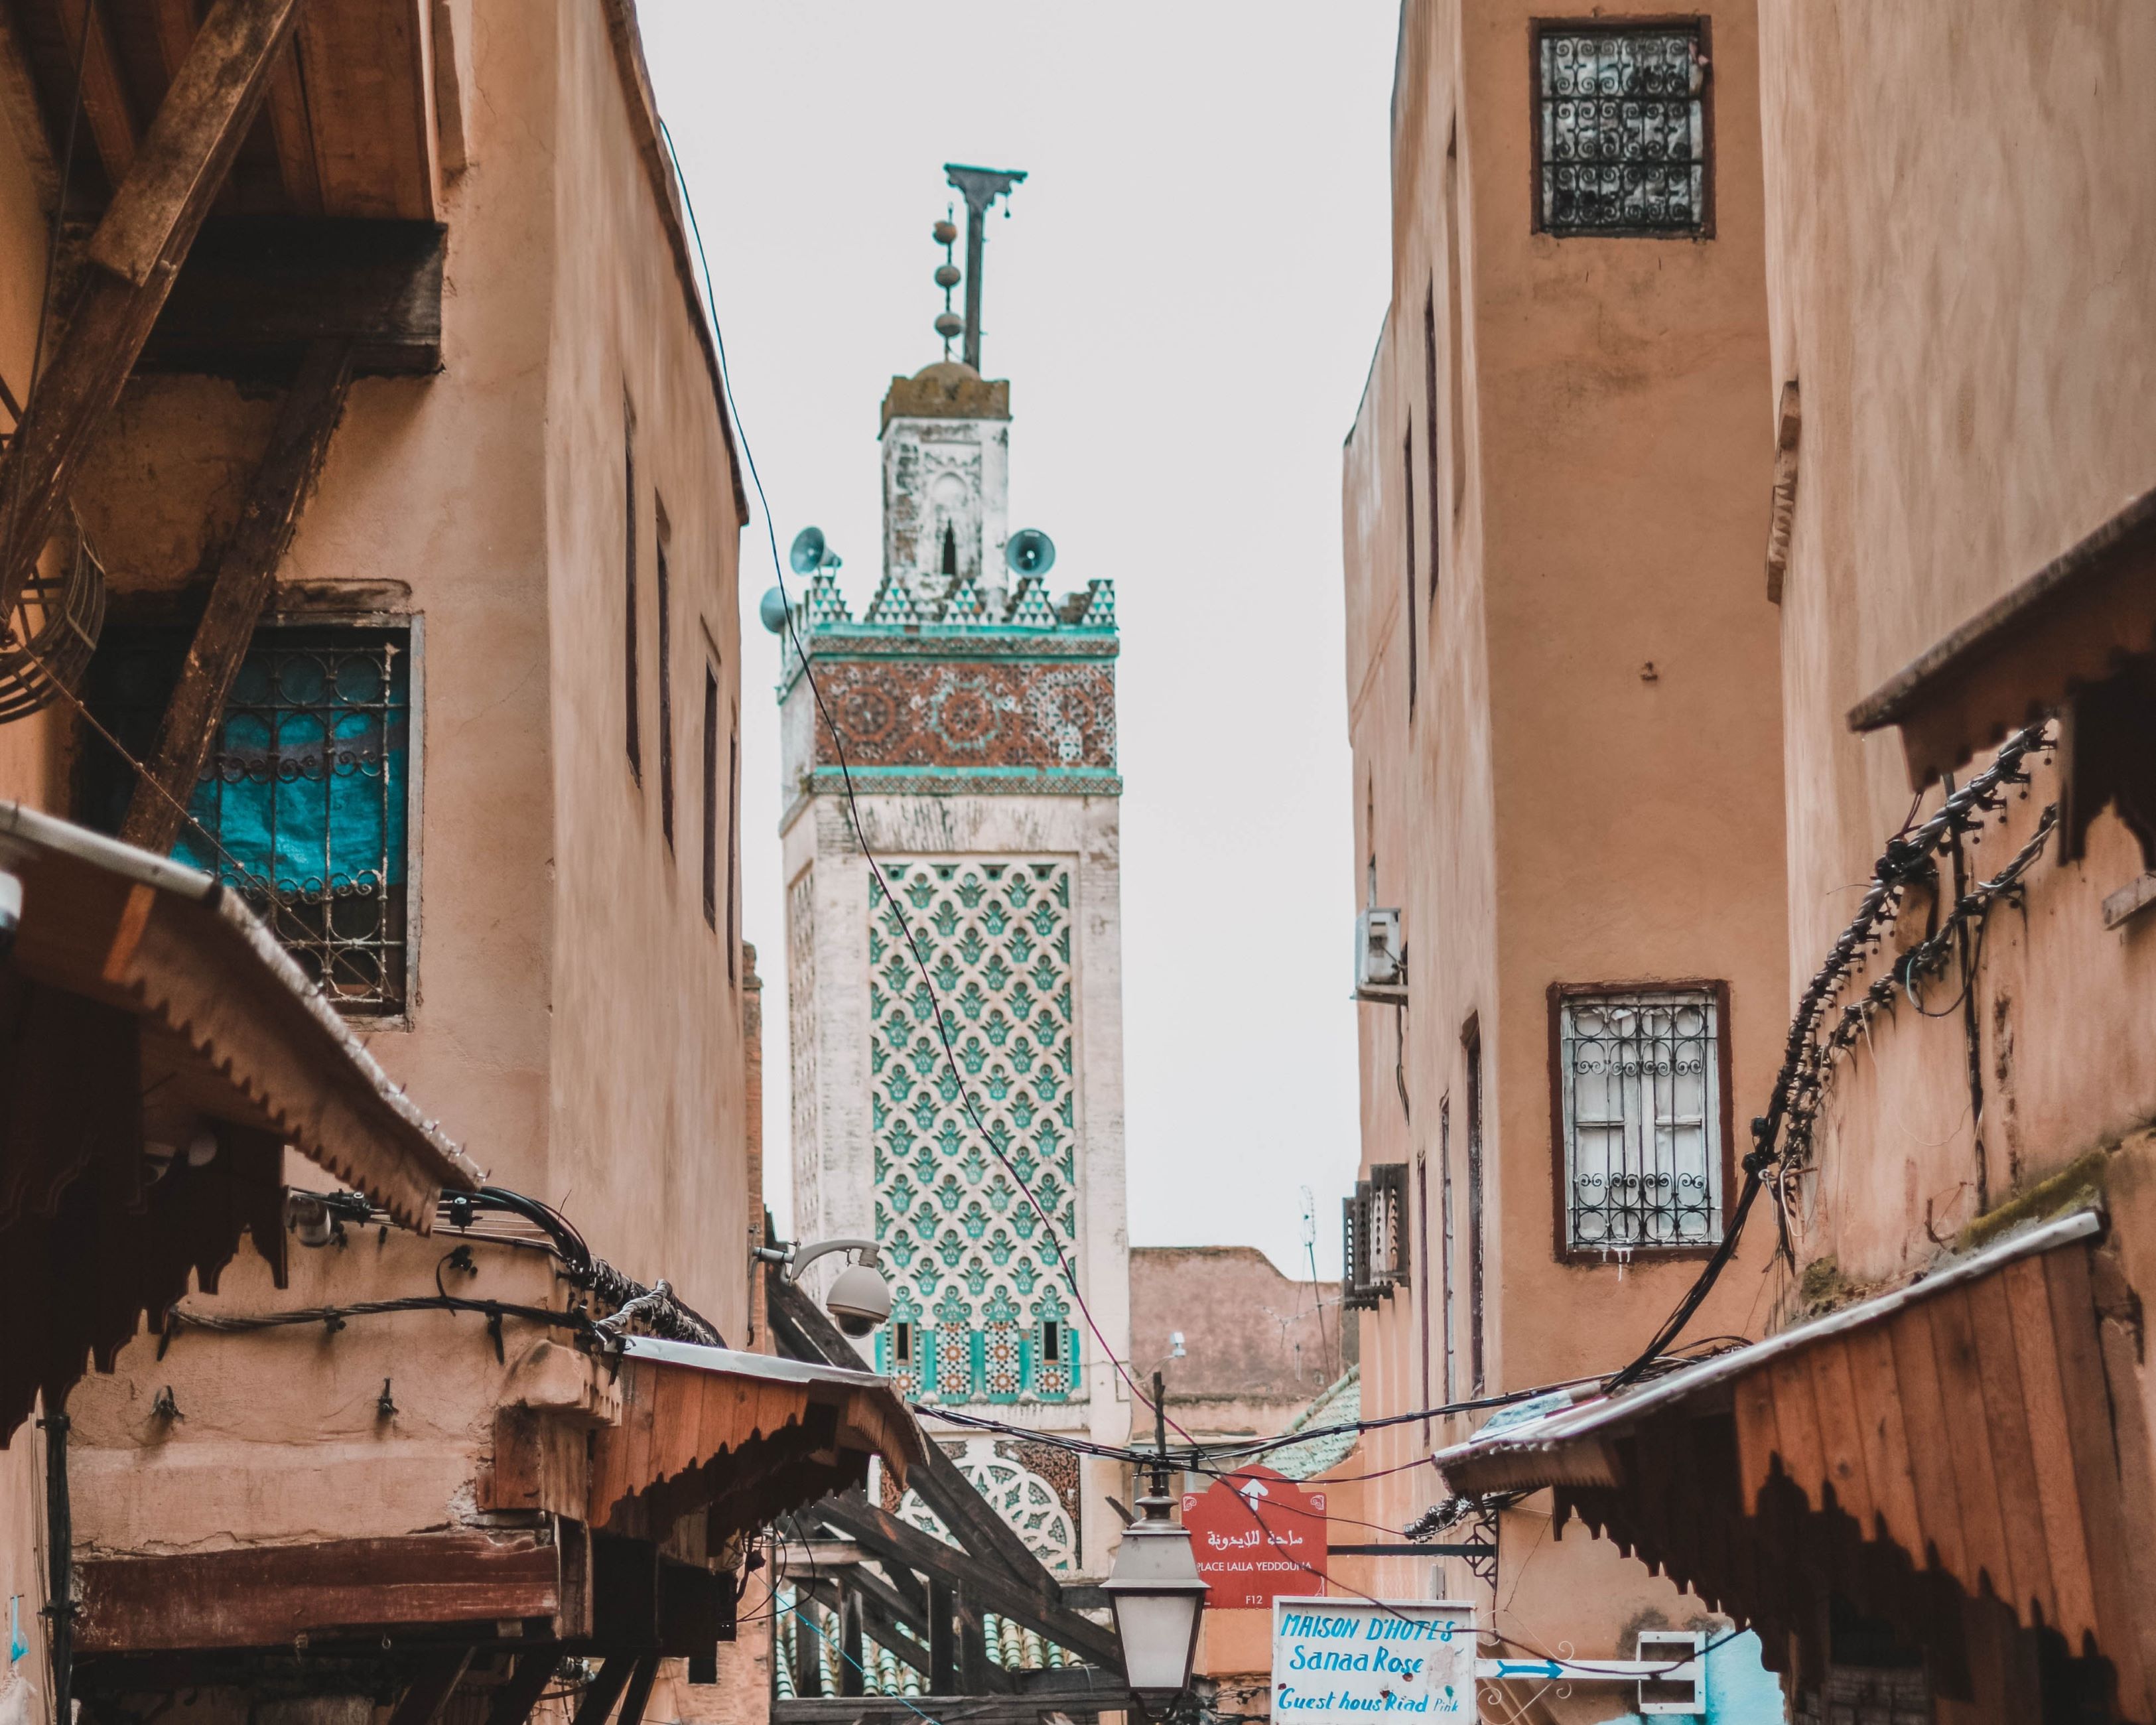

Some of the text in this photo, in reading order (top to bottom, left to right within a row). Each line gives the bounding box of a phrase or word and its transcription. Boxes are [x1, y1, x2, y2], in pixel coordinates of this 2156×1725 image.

[1227, 1562, 1254, 1572] LALLA
[1245, 1596, 1262, 1604] F12
[1280, 1613, 1360, 1639] MAISON
[1290, 1645, 1424, 1673] Sanaa Rose
[1278, 1687, 1336, 1710] Guest
